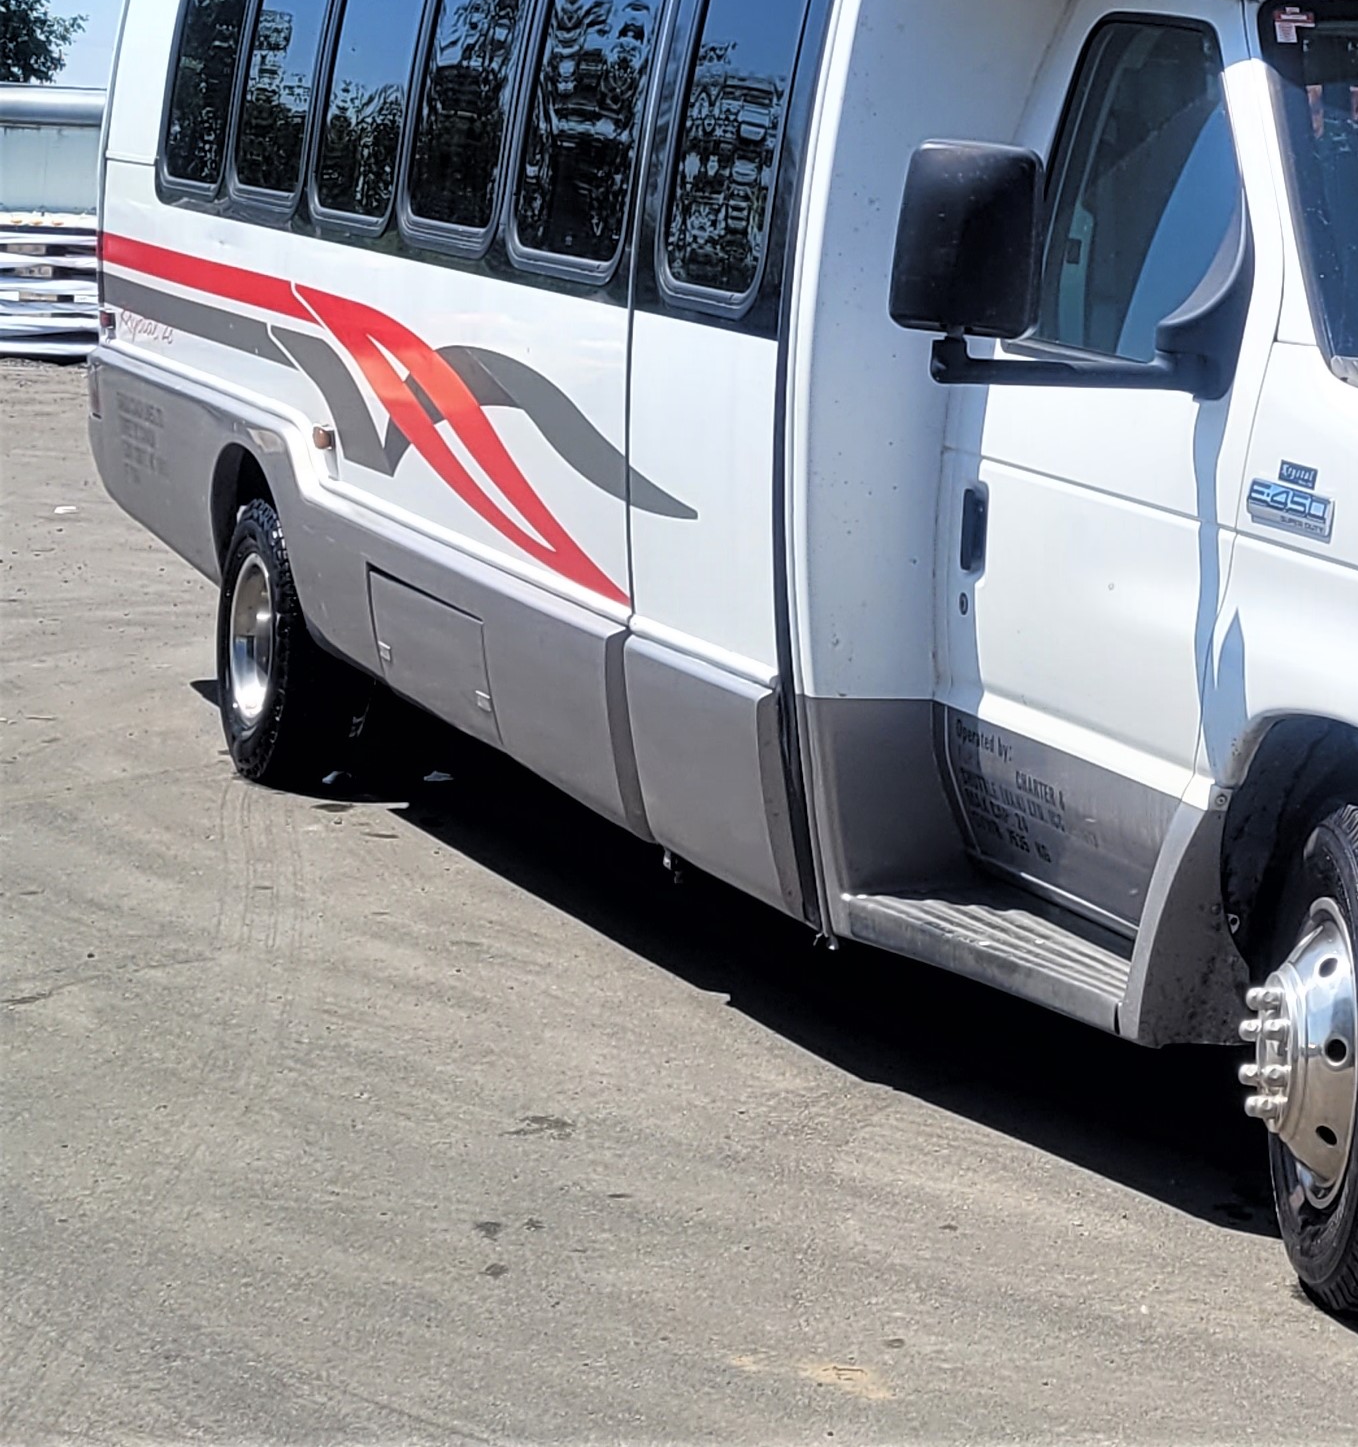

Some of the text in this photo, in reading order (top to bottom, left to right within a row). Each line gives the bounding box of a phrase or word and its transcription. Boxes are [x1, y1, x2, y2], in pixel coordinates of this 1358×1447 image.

[955, 718, 1012, 763] Operated by:
[1015, 770, 1056, 807] CHARTER
